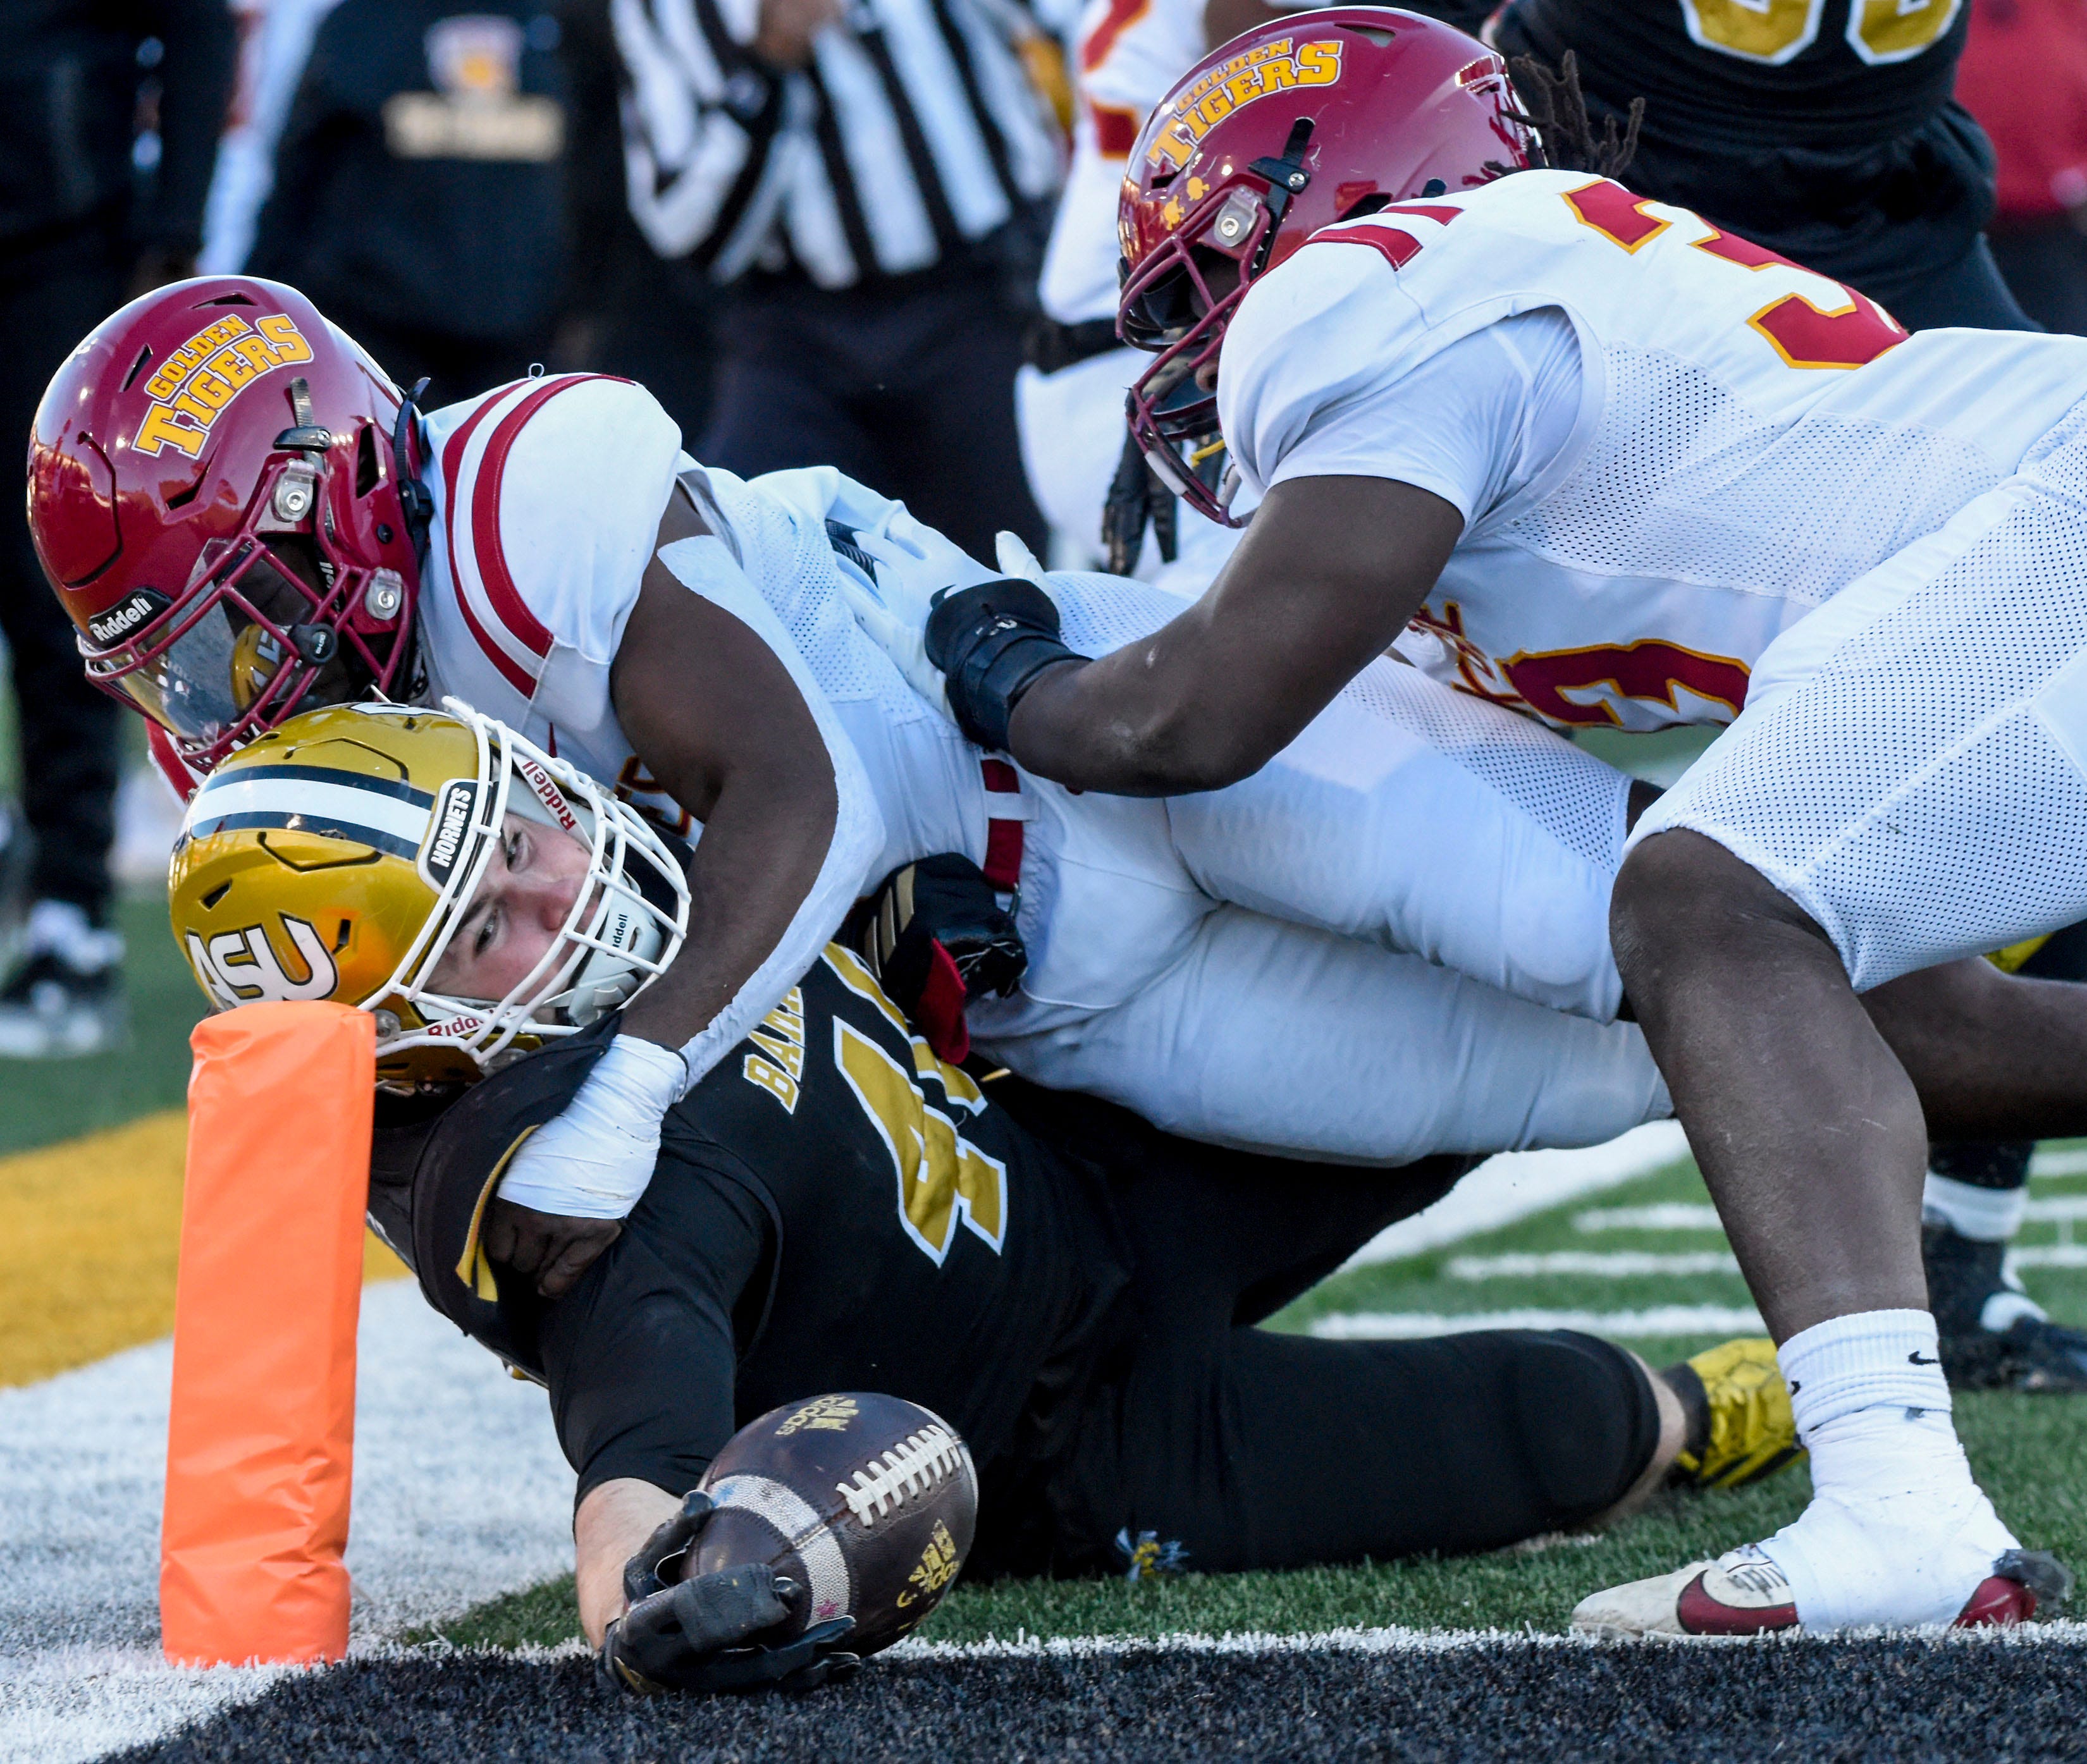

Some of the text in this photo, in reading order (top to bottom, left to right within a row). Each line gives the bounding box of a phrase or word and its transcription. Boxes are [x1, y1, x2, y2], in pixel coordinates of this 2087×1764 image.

[1146, 40, 1344, 172] TIGERS
[1175, 37, 1293, 114] GOLDEN
[131, 313, 314, 460] TIGERS
[144, 314, 254, 401] GOLDEN
[89, 596, 153, 641] Riddell
[430, 787, 472, 868] HORNETS
[522, 761, 577, 831] Riddell
[185, 912, 338, 1012] ASU
[609, 914, 628, 952] iddell
[428, 1012, 496, 1036] Ridd
